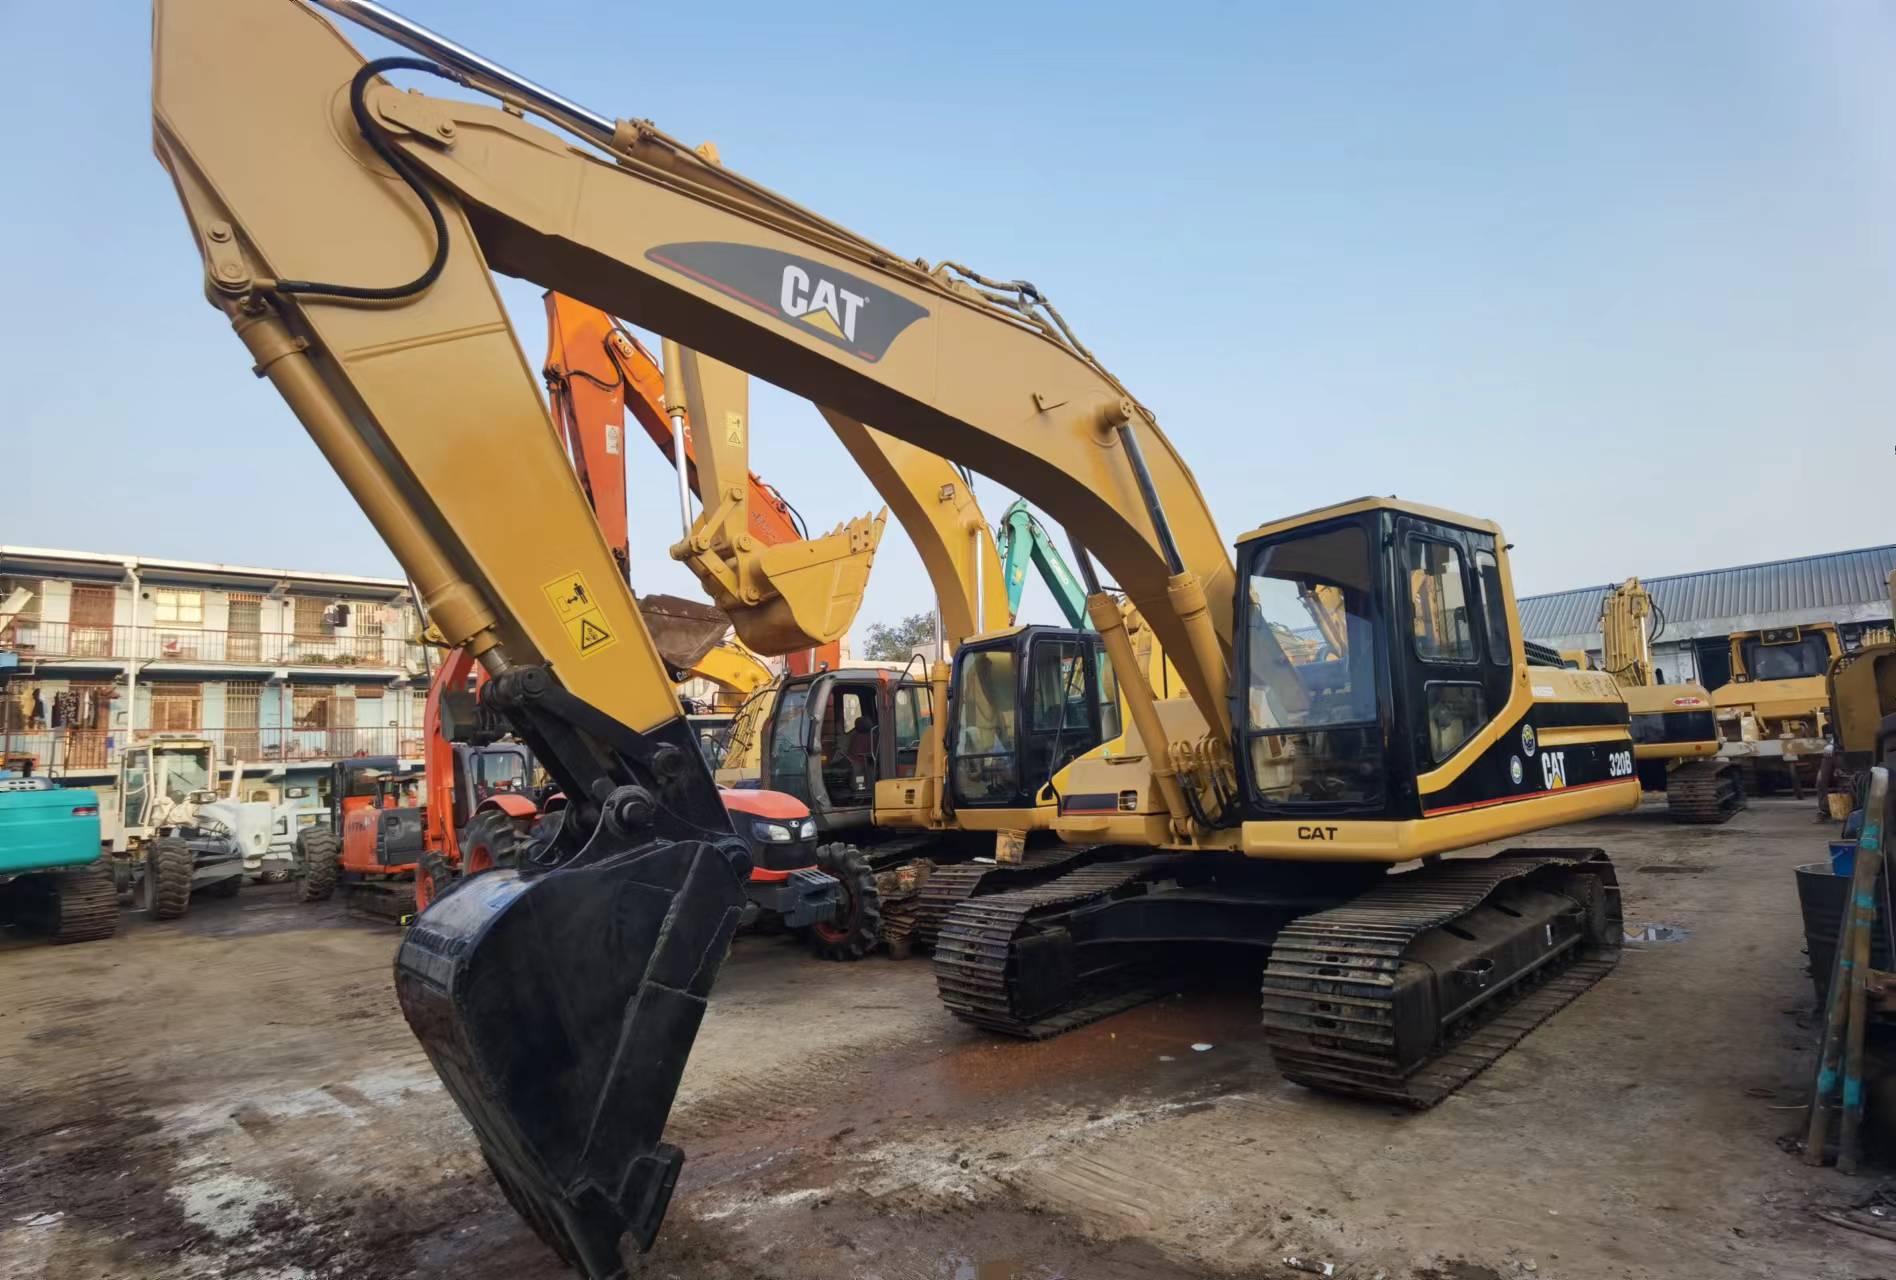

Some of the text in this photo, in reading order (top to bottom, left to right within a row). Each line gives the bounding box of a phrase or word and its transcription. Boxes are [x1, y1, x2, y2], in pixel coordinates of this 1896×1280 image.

[781, 265, 865, 343] CAT
[1541, 751, 1567, 790] CAT
[1609, 751, 1633, 776] 320B
[1297, 826, 1338, 841] CAT
